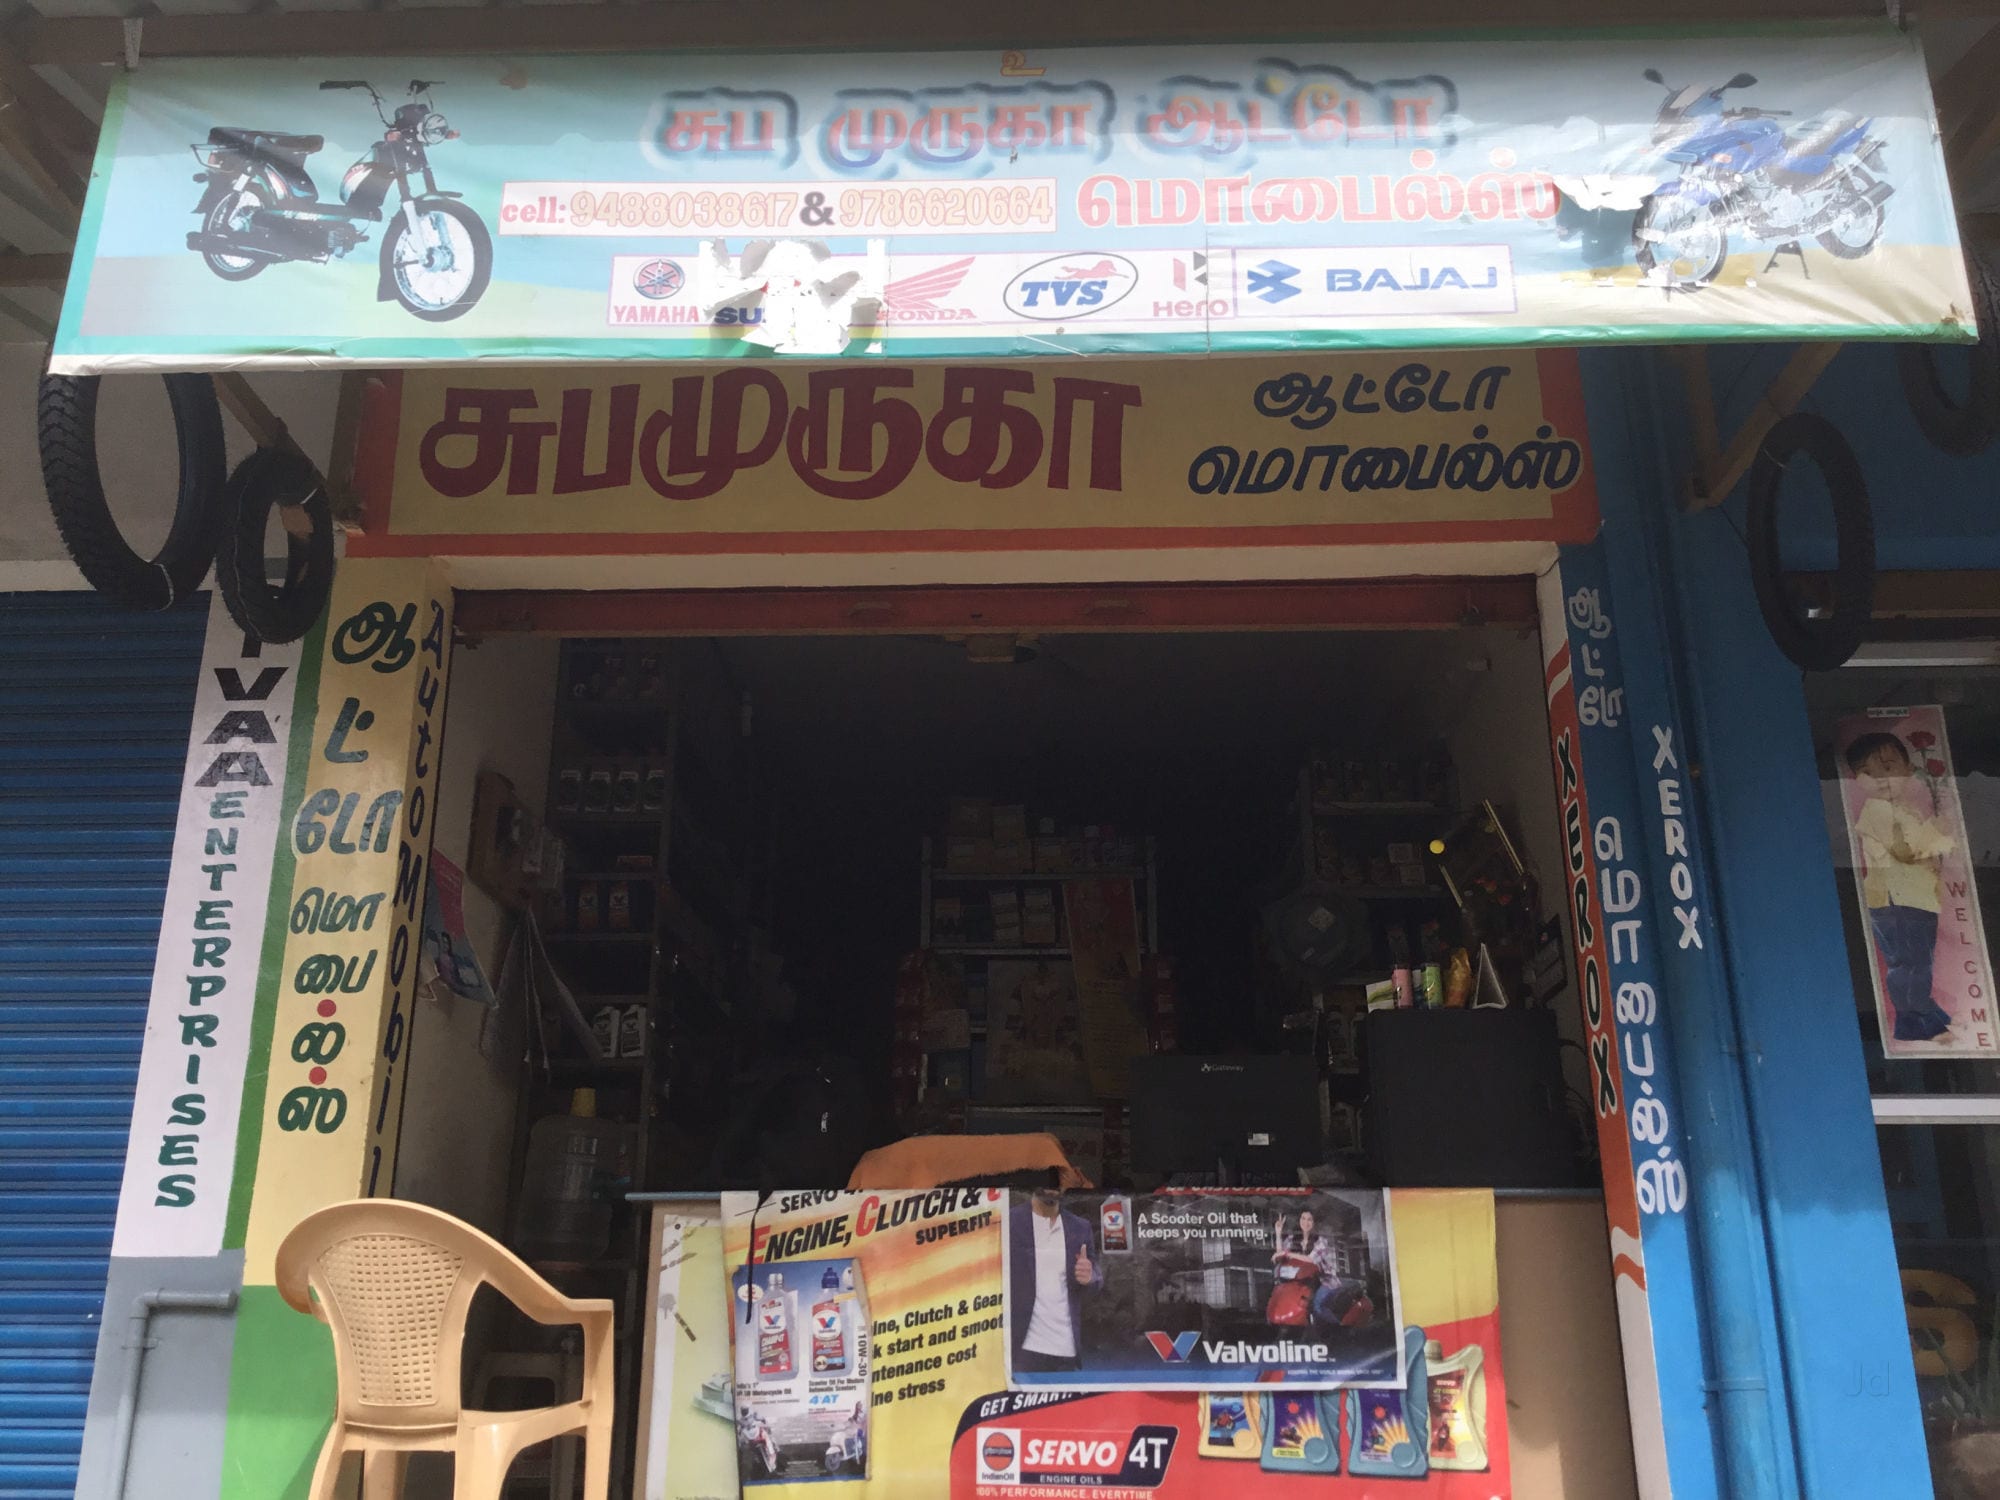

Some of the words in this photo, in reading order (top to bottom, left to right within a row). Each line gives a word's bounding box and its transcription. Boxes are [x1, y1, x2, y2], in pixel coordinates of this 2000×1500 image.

[662, 107, 778, 153] சுப
[826, 102, 1094, 168] முருகா
[1145, 76, 1436, 156] ஆட்டோ
[1077, 149, 1562, 228] மொபைல்ஸ்
[501, 196, 566, 224] cell:
[569, 190, 797, 228] 9488038617
[799, 191, 836, 226] &
[838, 187, 1053, 226] 9786620664
[1020, 279, 1108, 307] TVS
[1326, 264, 1497, 293] BAJAJ
[612, 304, 701, 324] YAMAHA
[1253, 362, 1511, 430] ஆட்டோ
[419, 366, 1142, 500] சுபமுருகா
[1187, 424, 1581, 495] மொபைல்ஸ்
[1651, 724, 1704, 950] XEROX
[1556, 726, 1618, 1119] XEROX
[1945, 880, 1991, 1048] WELCOME
[154, 790, 250, 1208] ENTERPRISES
[780, 1189, 839, 1214] SERVO
[1137, 1213, 1148, 1225] A
[1151, 1212, 1204, 1225] Scooter
[1207, 1212, 1226, 1225] Oil
[1230, 1212, 1258, 1225] that
[745, 1214, 853, 1265] ENGINE,
[855, 1187, 962, 1237] CLUTCH
[915, 1211, 993, 1246] SUPERFIT
[1138, 1227, 1180, 1241] keeps
[1183, 1229, 1208, 1241] you
[1210, 1226, 1268, 1241] running.
[904, 1305, 953, 1328] Clutch
[957, 1299, 969, 1316] &
[973, 1293, 1004, 1312] Gear
[887, 1333, 924, 1356] start
[928, 1325, 957, 1347] and
[1202, 1340, 1328, 1364] Valvoline
[871, 1355, 942, 1383] ntenance
[946, 1343, 977, 1366] cost
[897, 1378, 946, 1401] stress
[980, 1397, 1006, 1418] GET
[1024, 1438, 1118, 1467] SERVO
[1128, 1437, 1169, 1469] 4T
[1040, 1475, 1077, 1484] ENGINE
[1079, 1475, 1103, 1485] OILS
